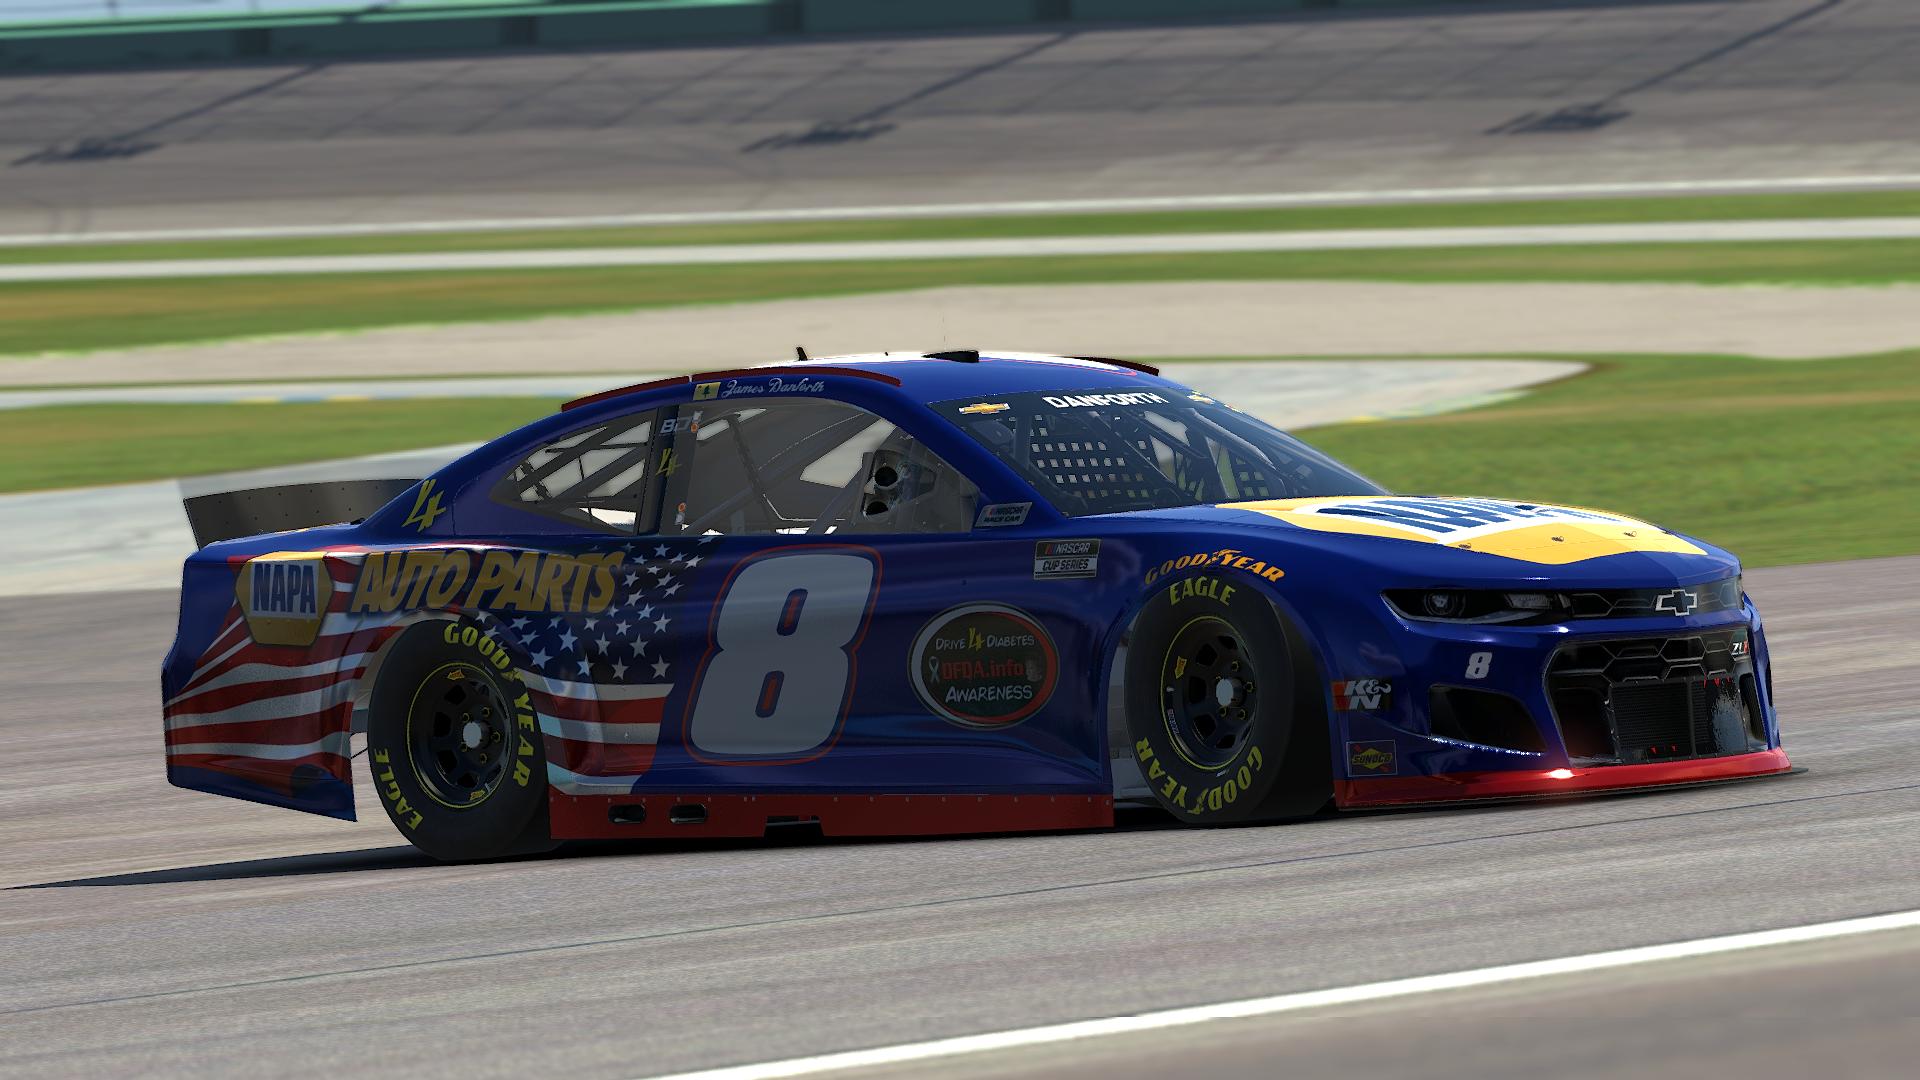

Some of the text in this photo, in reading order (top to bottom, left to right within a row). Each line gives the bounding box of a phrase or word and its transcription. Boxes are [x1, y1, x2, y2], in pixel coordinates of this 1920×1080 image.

[722, 377, 825, 397] James Danforth
[1043, 392, 1169, 409] DANFORTH
[401, 479, 447, 532] 4
[1042, 558, 1090, 571] CUP SERIES
[1055, 542, 1091, 554] NASCAR
[352, 551, 626, 613] AUTO PARTS
[1144, 549, 1286, 586] GOODYEAR
[253, 563, 317, 614] NAPA
[1168, 575, 1237, 606] EAGLE
[689, 553, 875, 756] 8
[968, 627, 985, 651] 4
[1465, 651, 1493, 680] 8
[444, 621, 535, 788] GOODYEAR
[375, 747, 424, 831] EAGLE
[1135, 737, 1264, 815] GOODYEAR
